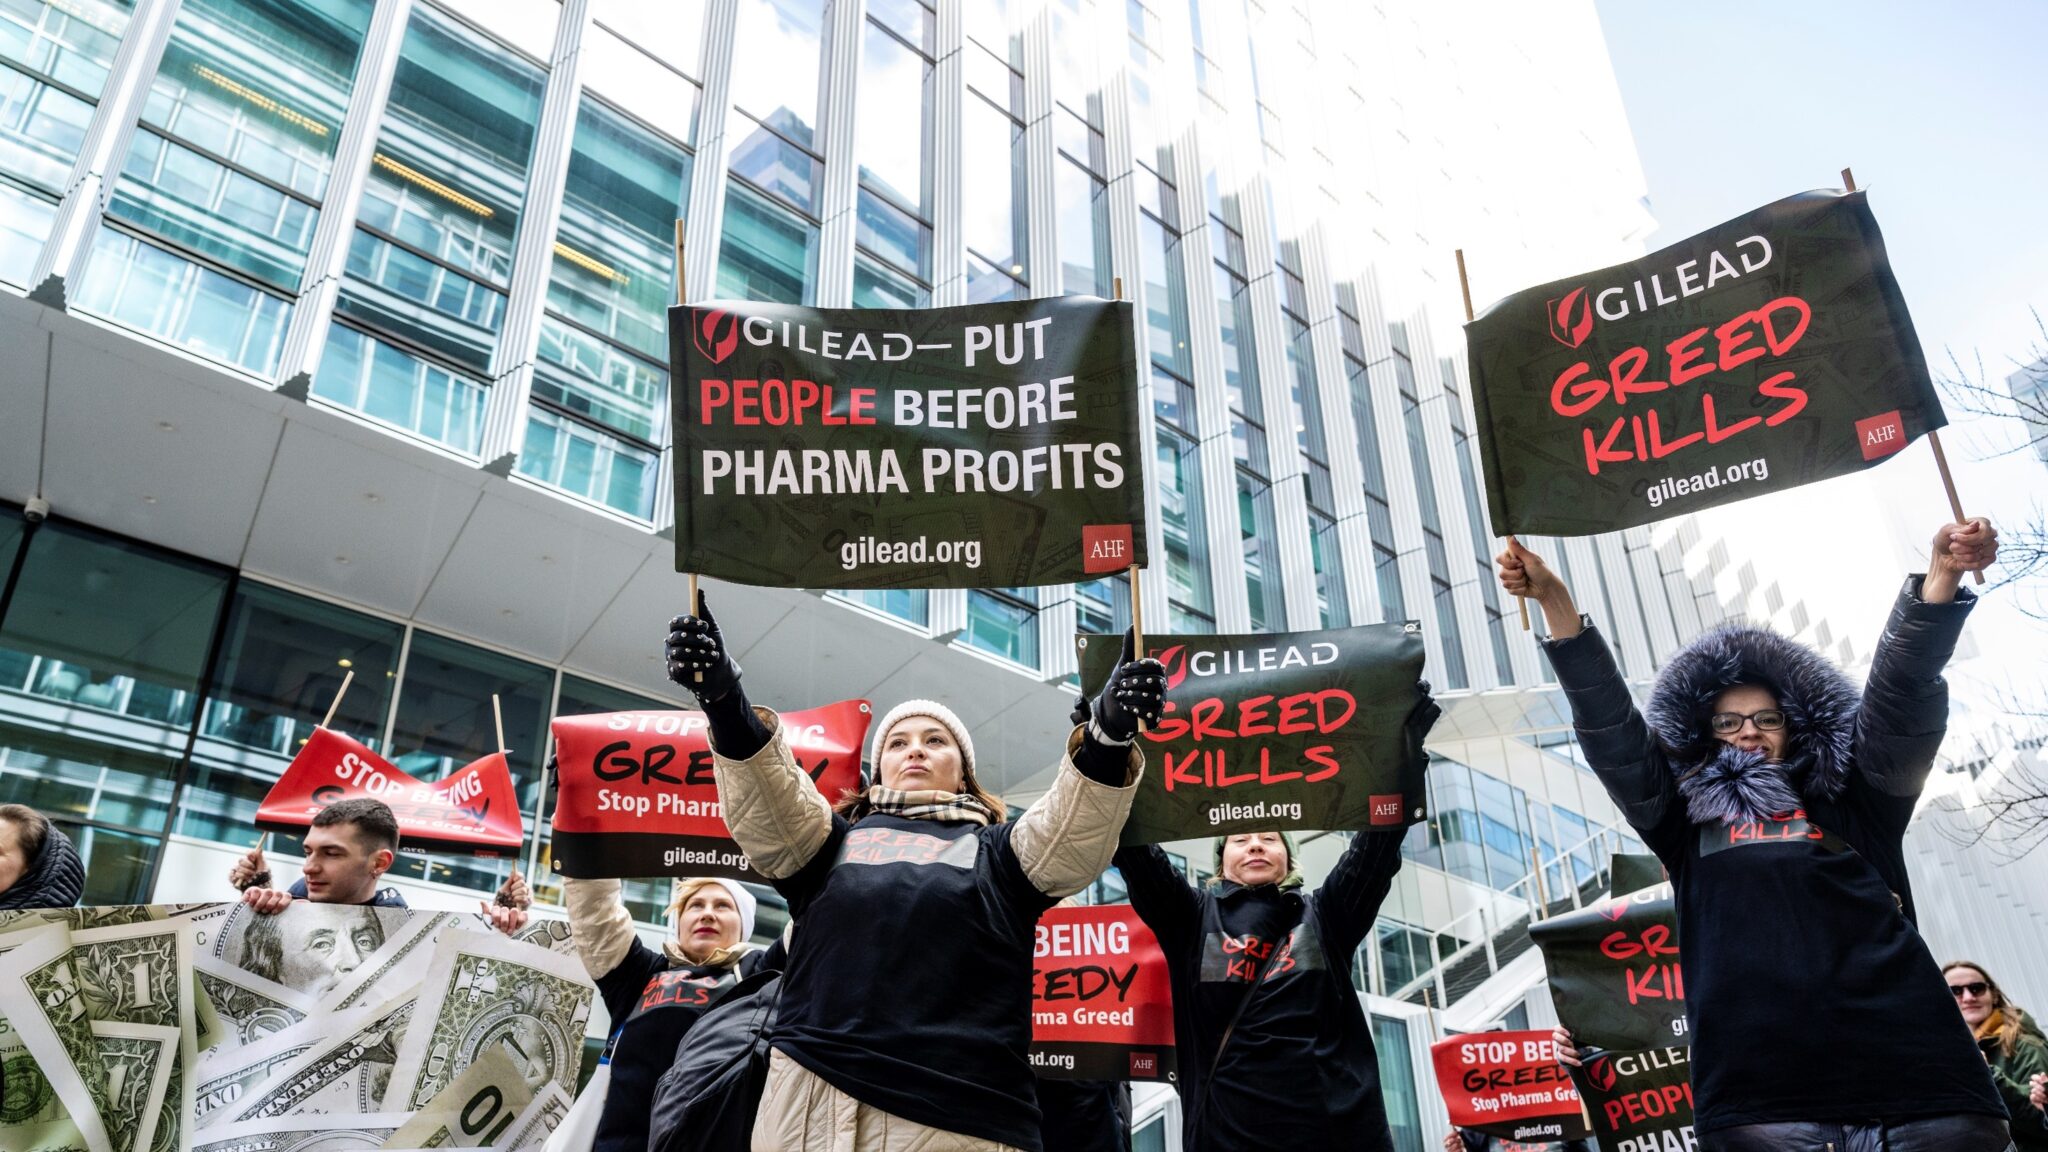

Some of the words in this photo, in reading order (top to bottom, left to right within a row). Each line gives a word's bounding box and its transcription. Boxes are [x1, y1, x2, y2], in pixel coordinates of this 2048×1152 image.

[1595, 234, 1773, 321] GILEAD
[964, 317, 1052, 367] PUT
[1550, 296, 1812, 417] GREED
[701, 379, 876, 426] PEOPLE
[894, 375, 1077, 430] BEFORE
[1583, 371, 1809, 475] KILLS
[1865, 424, 1896, 447] AHF
[702, 448, 909, 495] PHARMA
[922, 442, 1124, 498] PROFITS
[1646, 455, 1769, 508] gilead.org
[841, 535, 982, 571] gilead.org
[1090, 539, 1126, 559] AHF
[1190, 642, 1339, 676] GILEAD
[607, 712, 706, 737] STOP
[1143, 689, 1357, 742] GREED
[335, 752, 405, 799] STOP
[411, 770, 483, 807] BEING
[1164, 745, 1341, 792] KILLS
[311, 785, 491, 825] GEEDY
[597, 788, 651, 818] Stop
[657, 793, 725, 819] Phar
[1208, 801, 1302, 825] gilead.org
[1374, 802, 1398, 817] AHF
[1729, 822, 1824, 845] KILLS
[663, 847, 750, 871] gilead.org
[846, 847, 939, 862] KILLS
[190, 908, 226, 922] NOTE
[1033, 921, 1130, 958] BEING
[640, 986, 710, 1012] KILLS
[1072, 1006, 1135, 1027] Greed
[320, 1045, 366, 1080] ONE
[1028, 1052, 1075, 1070] ad.org
[1133, 1059, 1153, 1070] AHF
[1460, 1041, 1517, 1065] STOP
[1524, 1040, 1560, 1063] BEI
[1615, 1047, 1691, 1077] GILE
[1471, 1094, 1500, 1113] Stop
[1500, 1087, 1552, 1111] Pharma
[1554, 1086, 1578, 1103] Gre
[1513, 1123, 1562, 1140] gilead.org
[1617, 1125, 1699, 1152] PHAR
